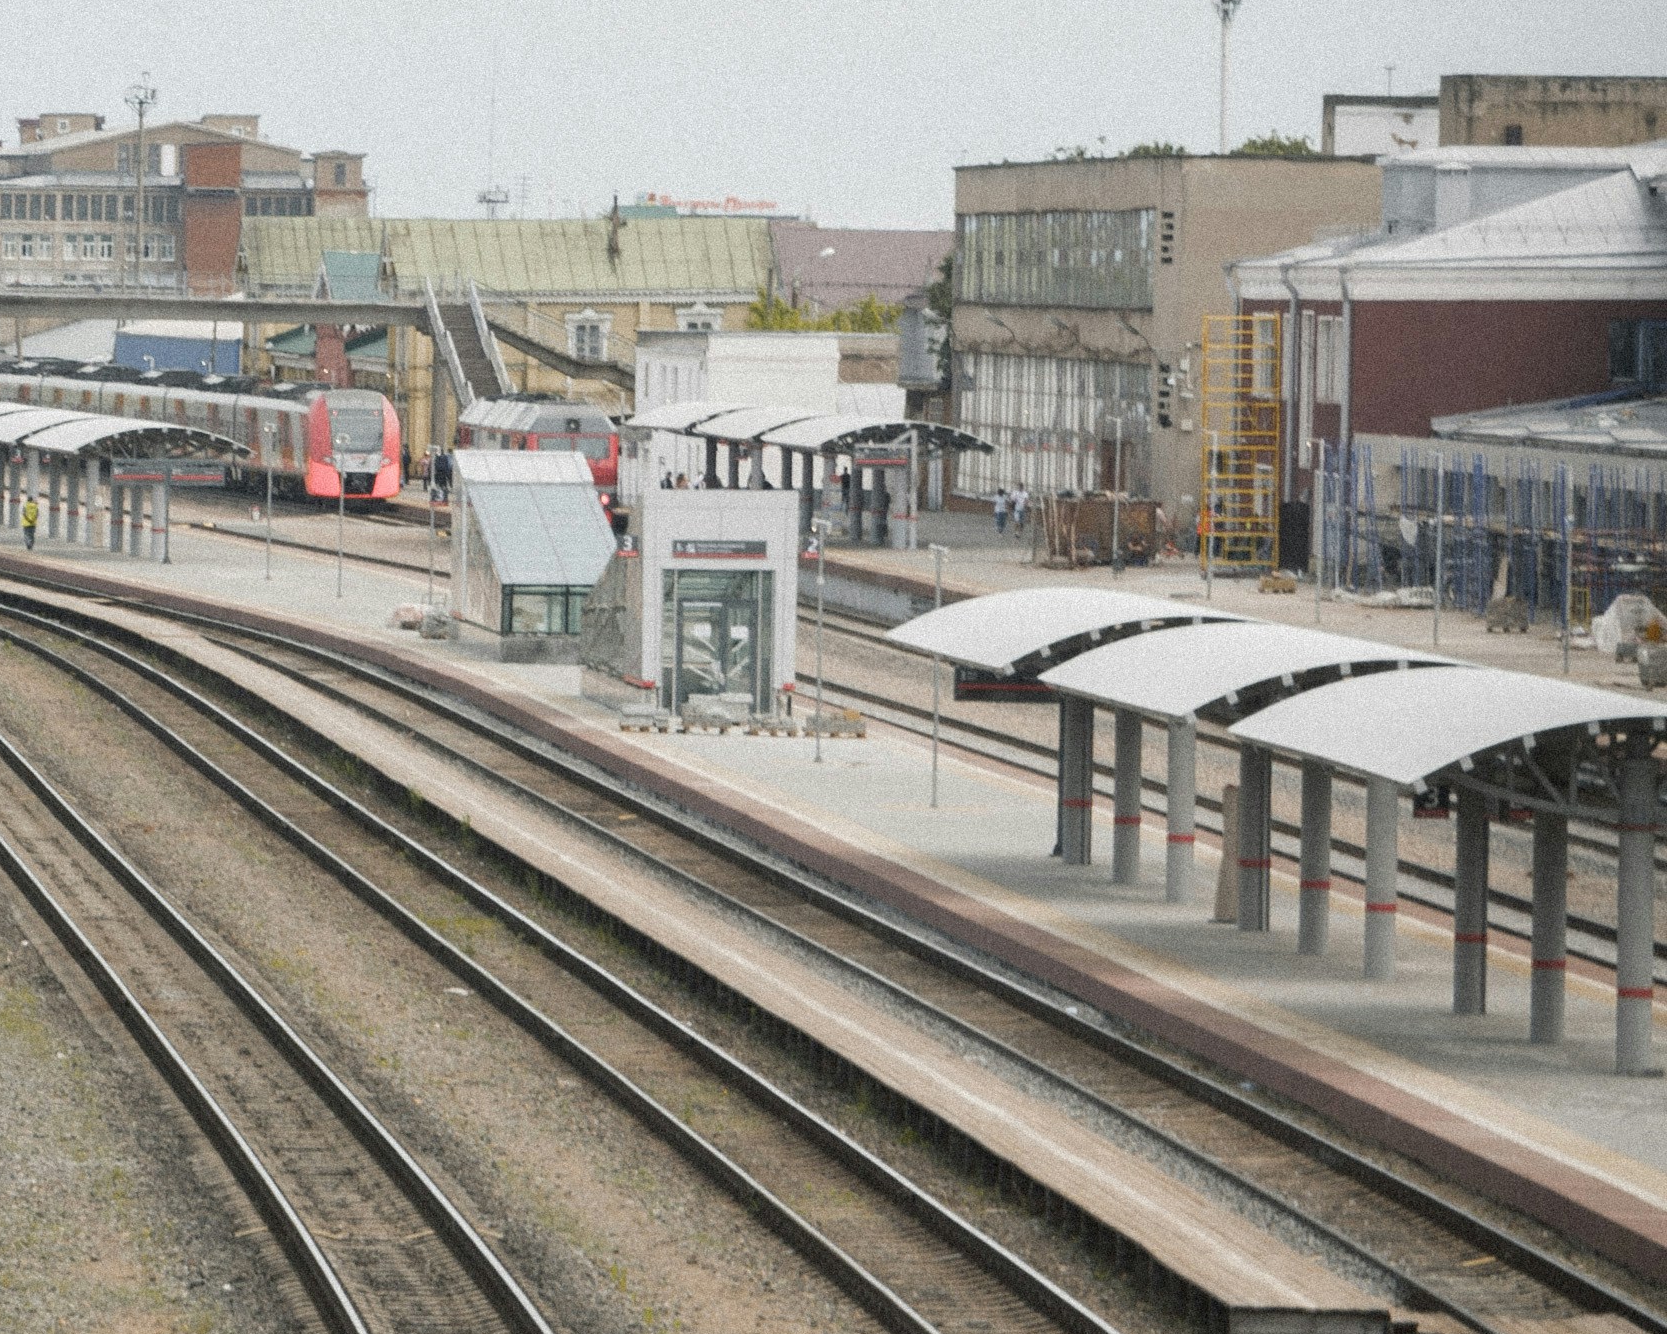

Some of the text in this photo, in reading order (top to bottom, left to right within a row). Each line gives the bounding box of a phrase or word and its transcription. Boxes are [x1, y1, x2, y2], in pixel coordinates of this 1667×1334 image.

[622, 534, 633, 551] 3
[807, 536, 818, 553] 2
[1424, 786, 1439, 808] 3
